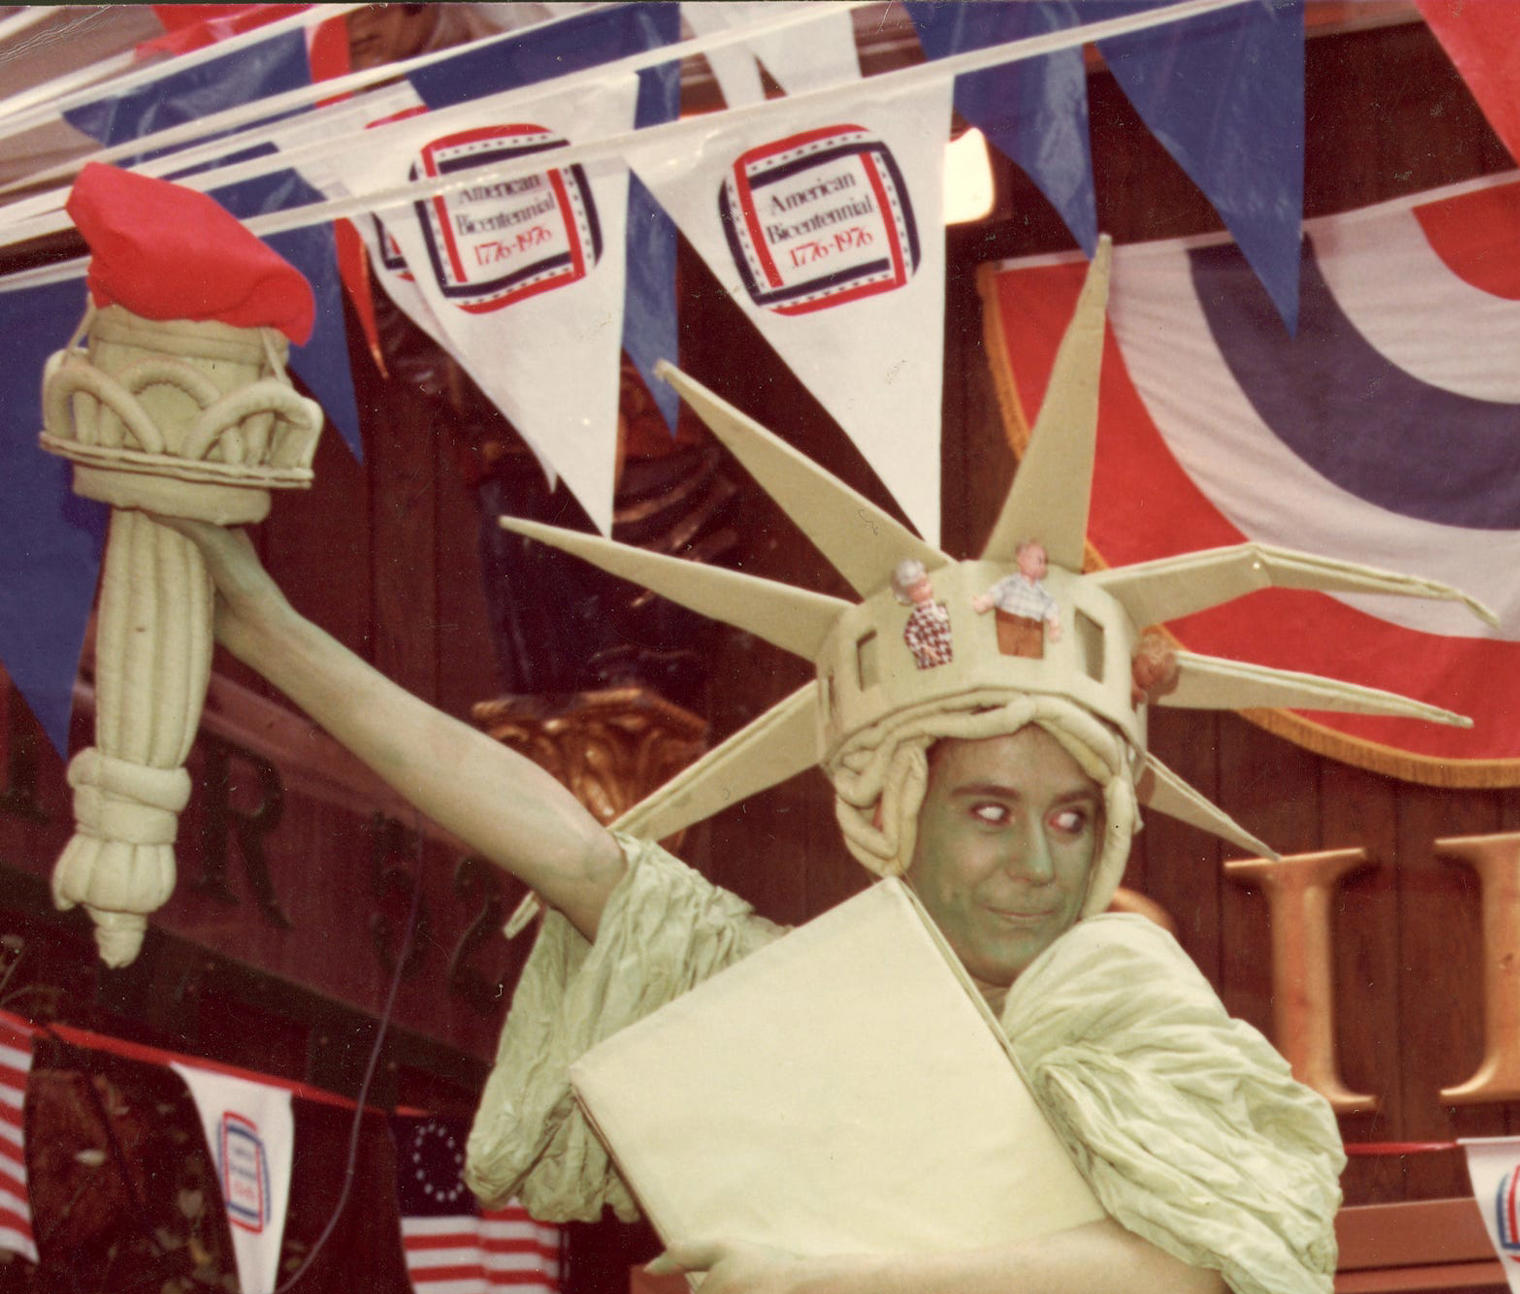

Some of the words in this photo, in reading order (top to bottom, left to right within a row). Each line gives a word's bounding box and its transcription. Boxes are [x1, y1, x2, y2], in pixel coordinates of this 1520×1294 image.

[459, 174, 541, 204] American
[771, 172, 856, 216] American
[455, 190, 555, 236] Bicentennial
[766, 194, 873, 244] Bicentennial
[474, 225, 552, 265] 1776-1976
[790, 227, 873, 267] 1776-1976
